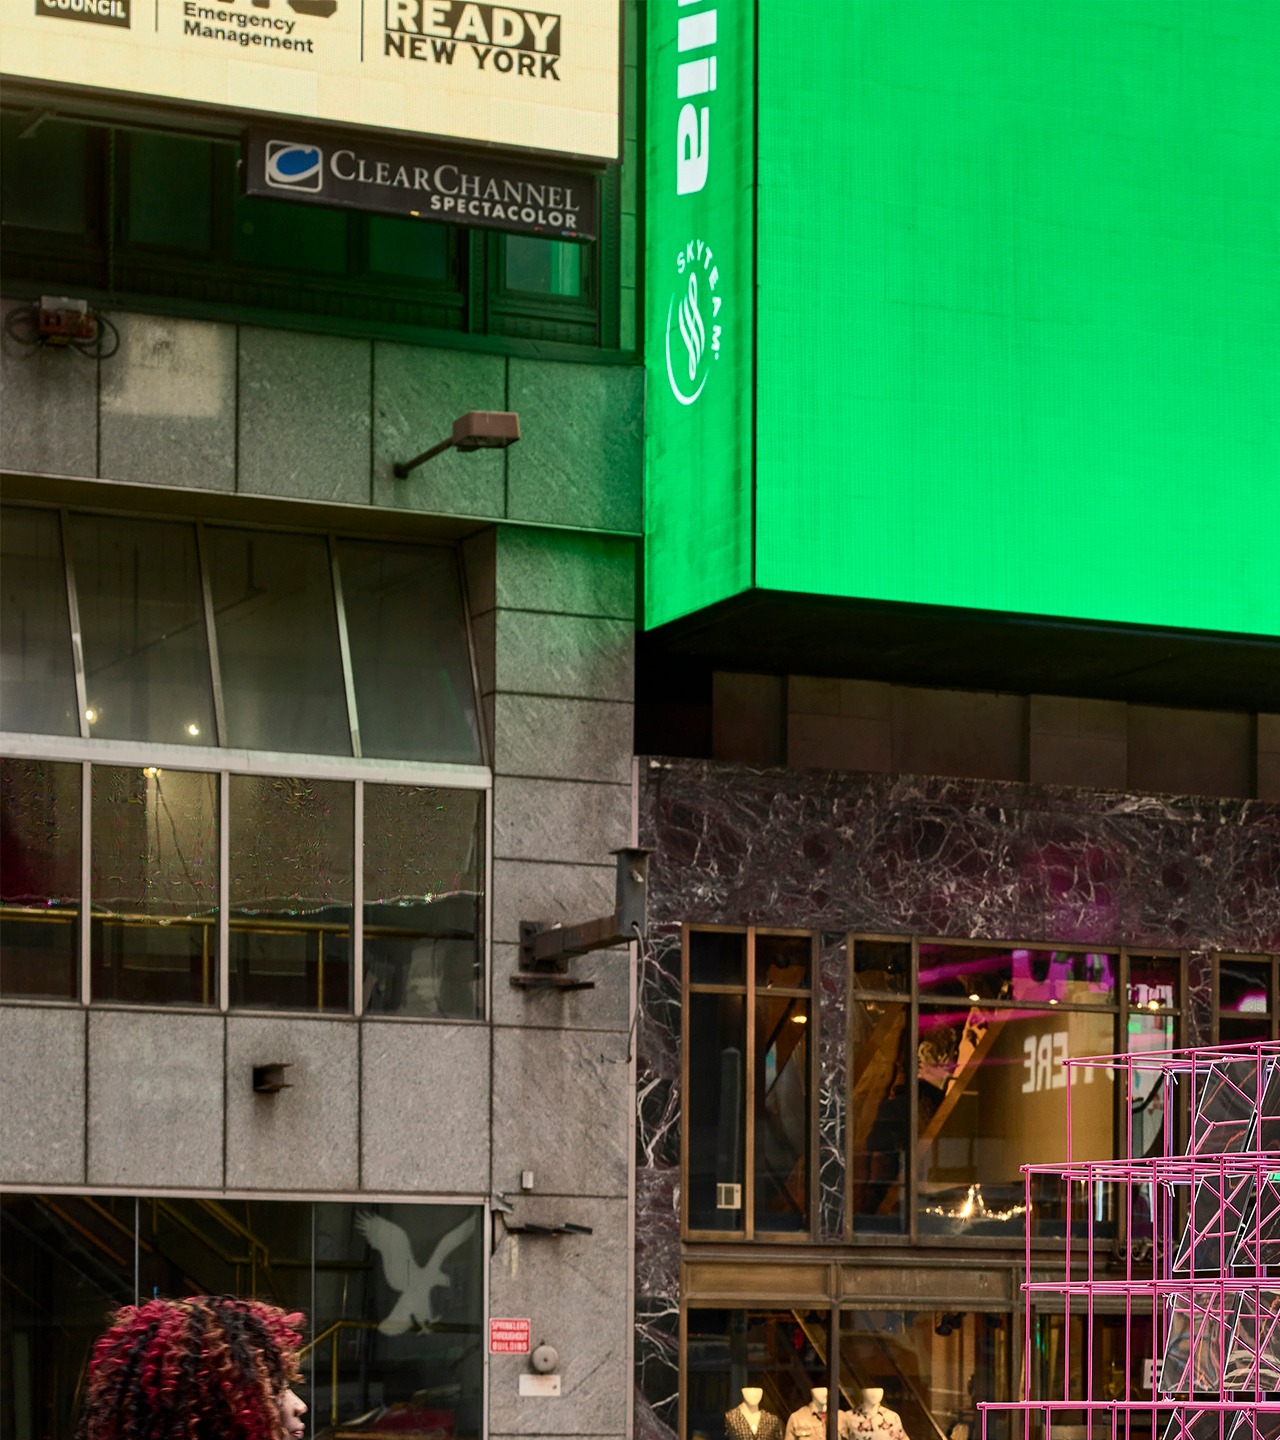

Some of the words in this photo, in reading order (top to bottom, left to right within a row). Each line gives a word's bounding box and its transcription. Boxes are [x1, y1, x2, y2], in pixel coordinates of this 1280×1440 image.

[184, 2, 296, 34] Emergency
[184, 20, 314, 53] Management
[386, 0, 559, 53] READY
[384, 30, 457, 65] NEW
[471, 45, 561, 81] YORK
[430, 194, 578, 229] SPECTACOLOR
[676, 238, 722, 360] SKYTEAM
